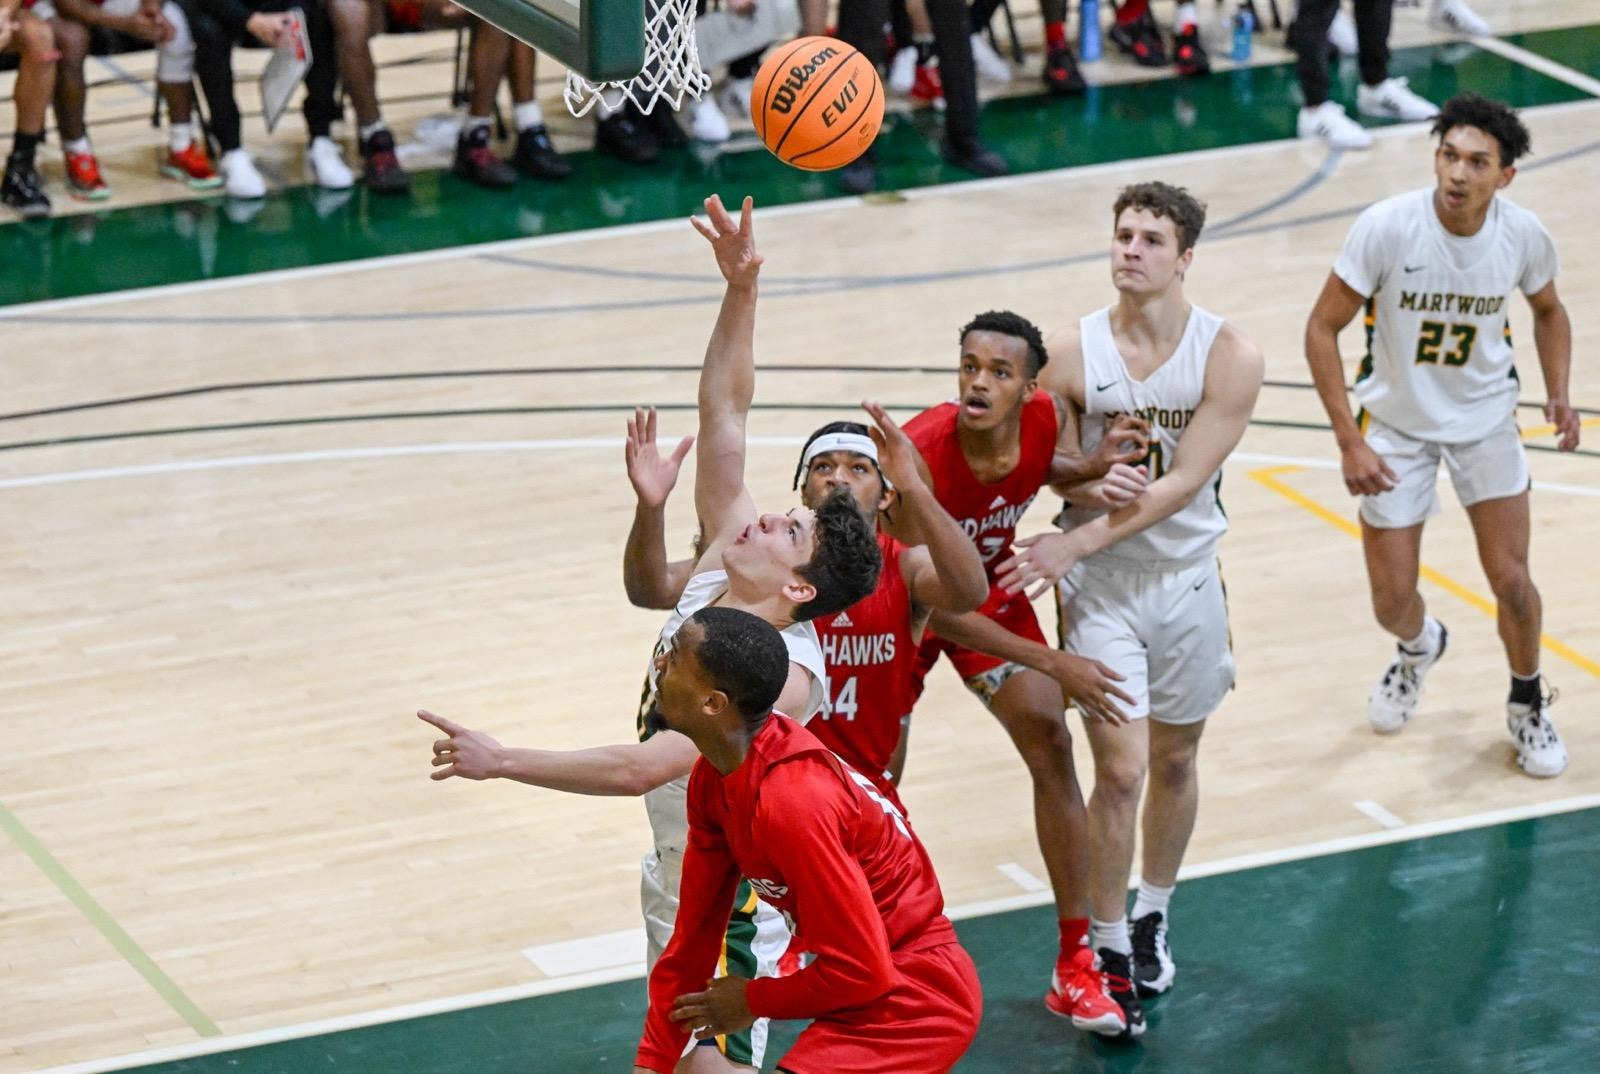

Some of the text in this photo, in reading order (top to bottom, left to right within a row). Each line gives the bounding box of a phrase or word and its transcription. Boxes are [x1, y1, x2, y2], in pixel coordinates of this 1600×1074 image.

[771, 47, 840, 114] Wilson
[1415, 320, 1478, 368] 23
[822, 632, 896, 667] HAWKS
